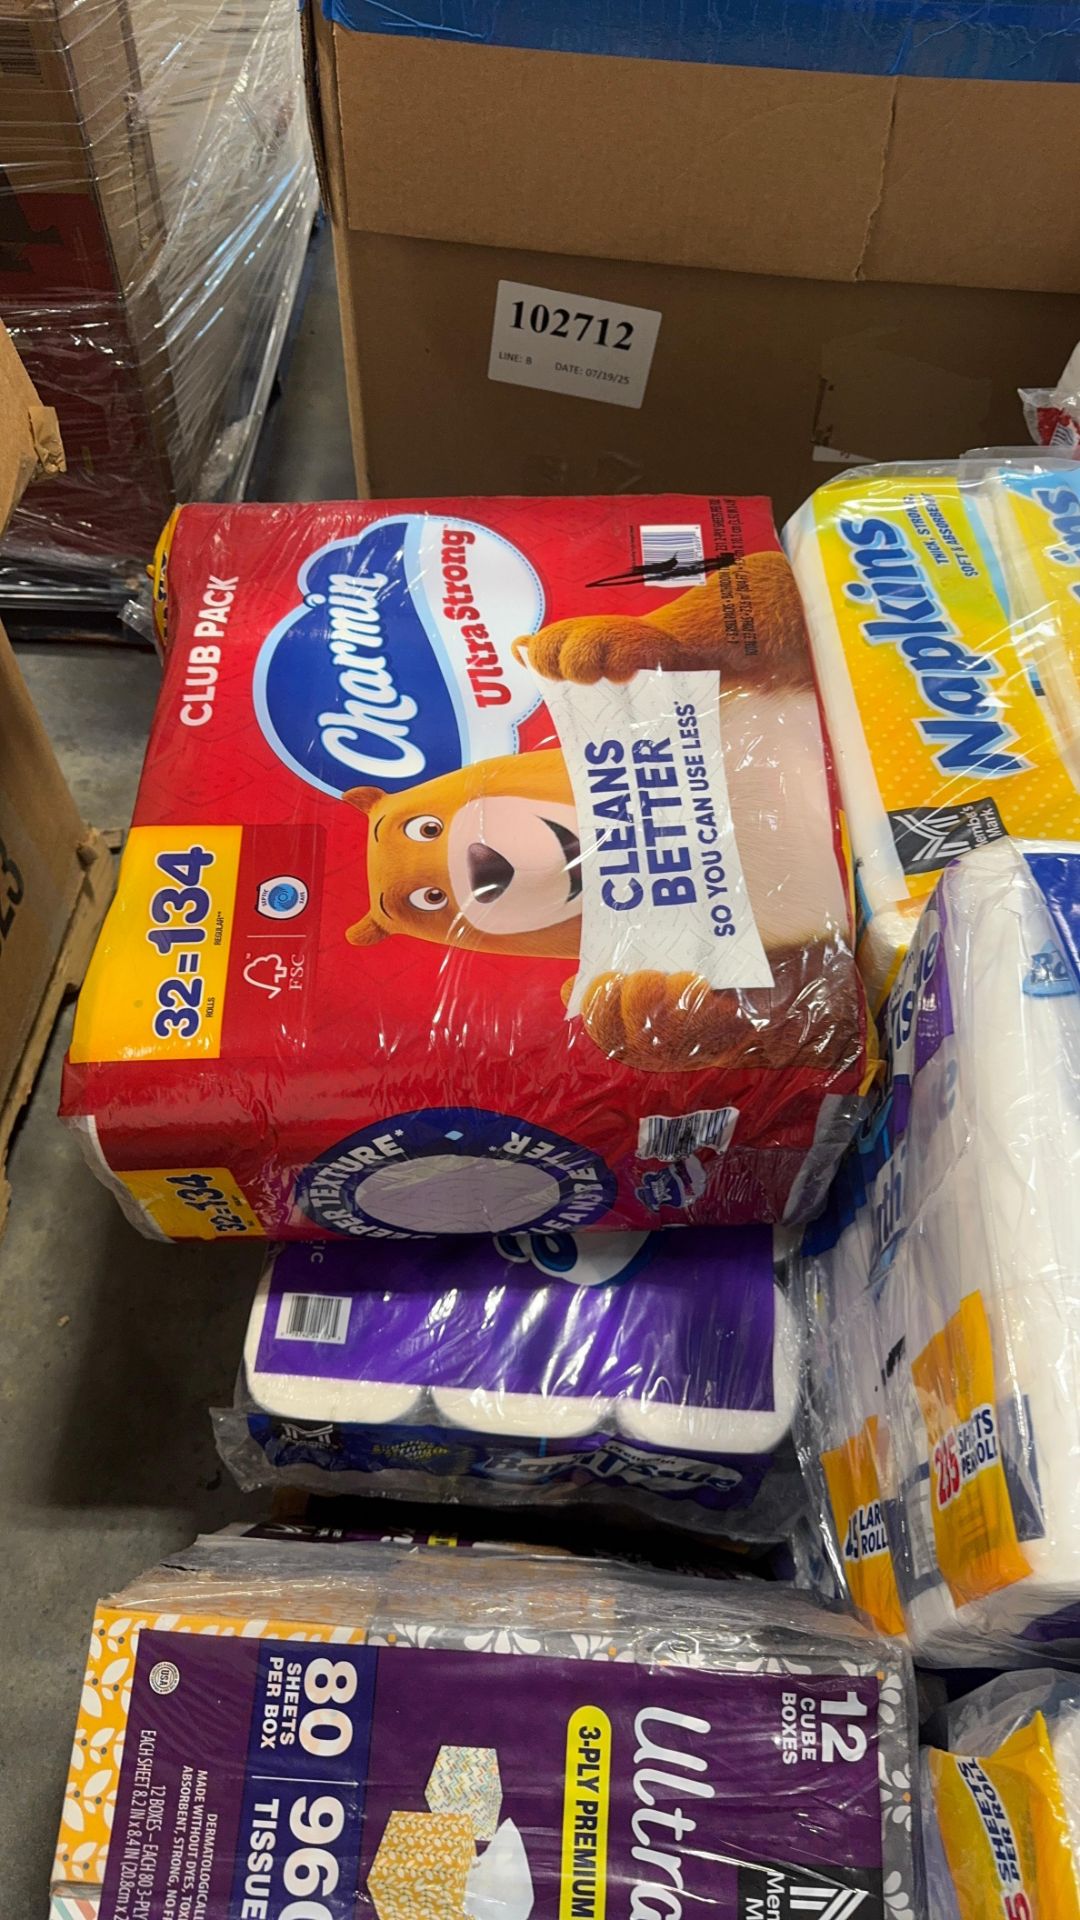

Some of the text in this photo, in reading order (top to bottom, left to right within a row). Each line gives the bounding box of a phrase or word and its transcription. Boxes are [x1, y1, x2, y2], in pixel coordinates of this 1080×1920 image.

[510, 301, 634, 351] 102712
[498, 351, 522, 363] LINE:
[555, 362, 583, 375] DATE:
[585, 368, 630, 385] 07/19/25
[954, 552, 979, 578] SOFT
[441, 529, 512, 709] Ultra Strong
[180, 574, 239, 727] CLUB PACK
[839, 517, 1026, 772] Napkins
[306, 572, 427, 779] Charmin
[683, 754, 710, 792] USE
[584, 739, 644, 911] CLEANS
[631, 737, 698, 906] BETTER
[693, 797, 718, 844] CAN
[962, 805, 989, 848] ember's
[979, 807, 1003, 838] Mark
[701, 850, 728, 900] YOU
[710, 904, 736, 937] SO
[289, 953, 305, 991] FSC
[206, 996, 216, 1018] ROLLS
[160, 1669, 170, 1686] USA
[260, 1656, 285, 1749] PER BOX
[279, 1662, 303, 1747] SHEETS
[299, 1657, 358, 1757] 80
[138, 1729, 157, 1756] EACH
[781, 1692, 798, 1765] BOXES
[800, 1697, 817, 1761] CUBE
[820, 1691, 868, 1763] 12
[134, 1757, 153, 1789] SHEET
[150, 1784, 166, 1797] 12
[194, 1769, 208, 1803] MADE
[129, 1808, 146, 1820] IN
[131, 1790, 148, 1806] 8.2
[145, 1798, 166, 1832] BOXES
[173, 1764, 194, 1834] ABSORBENT,
[630, 1706, 716, 1920] Ultra
[125, 1829, 143, 1846] 8.4
[187, 1804, 205, 1859] WITHOUT
[571, 1725, 602, 1919] 3-PLY PREMIUM
[958, 1761, 1013, 1884] SHEETS
[123, 1847, 140, 1860] IN
[140, 1844, 159, 1872] EACH
[166, 1836, 184, 1887] STRONG,
[240, 1798, 280, 1920] TISSUE
[1001, 1826, 1021, 1882] PER
[117, 1861, 138, 1904] (20.8cm
[137, 1873, 154, 1888] 80
[165, 1889, 178, 1908] NO
[181, 1861, 197, 1893] DYES,
[132, 1888, 152, 1920] 3-PLY
